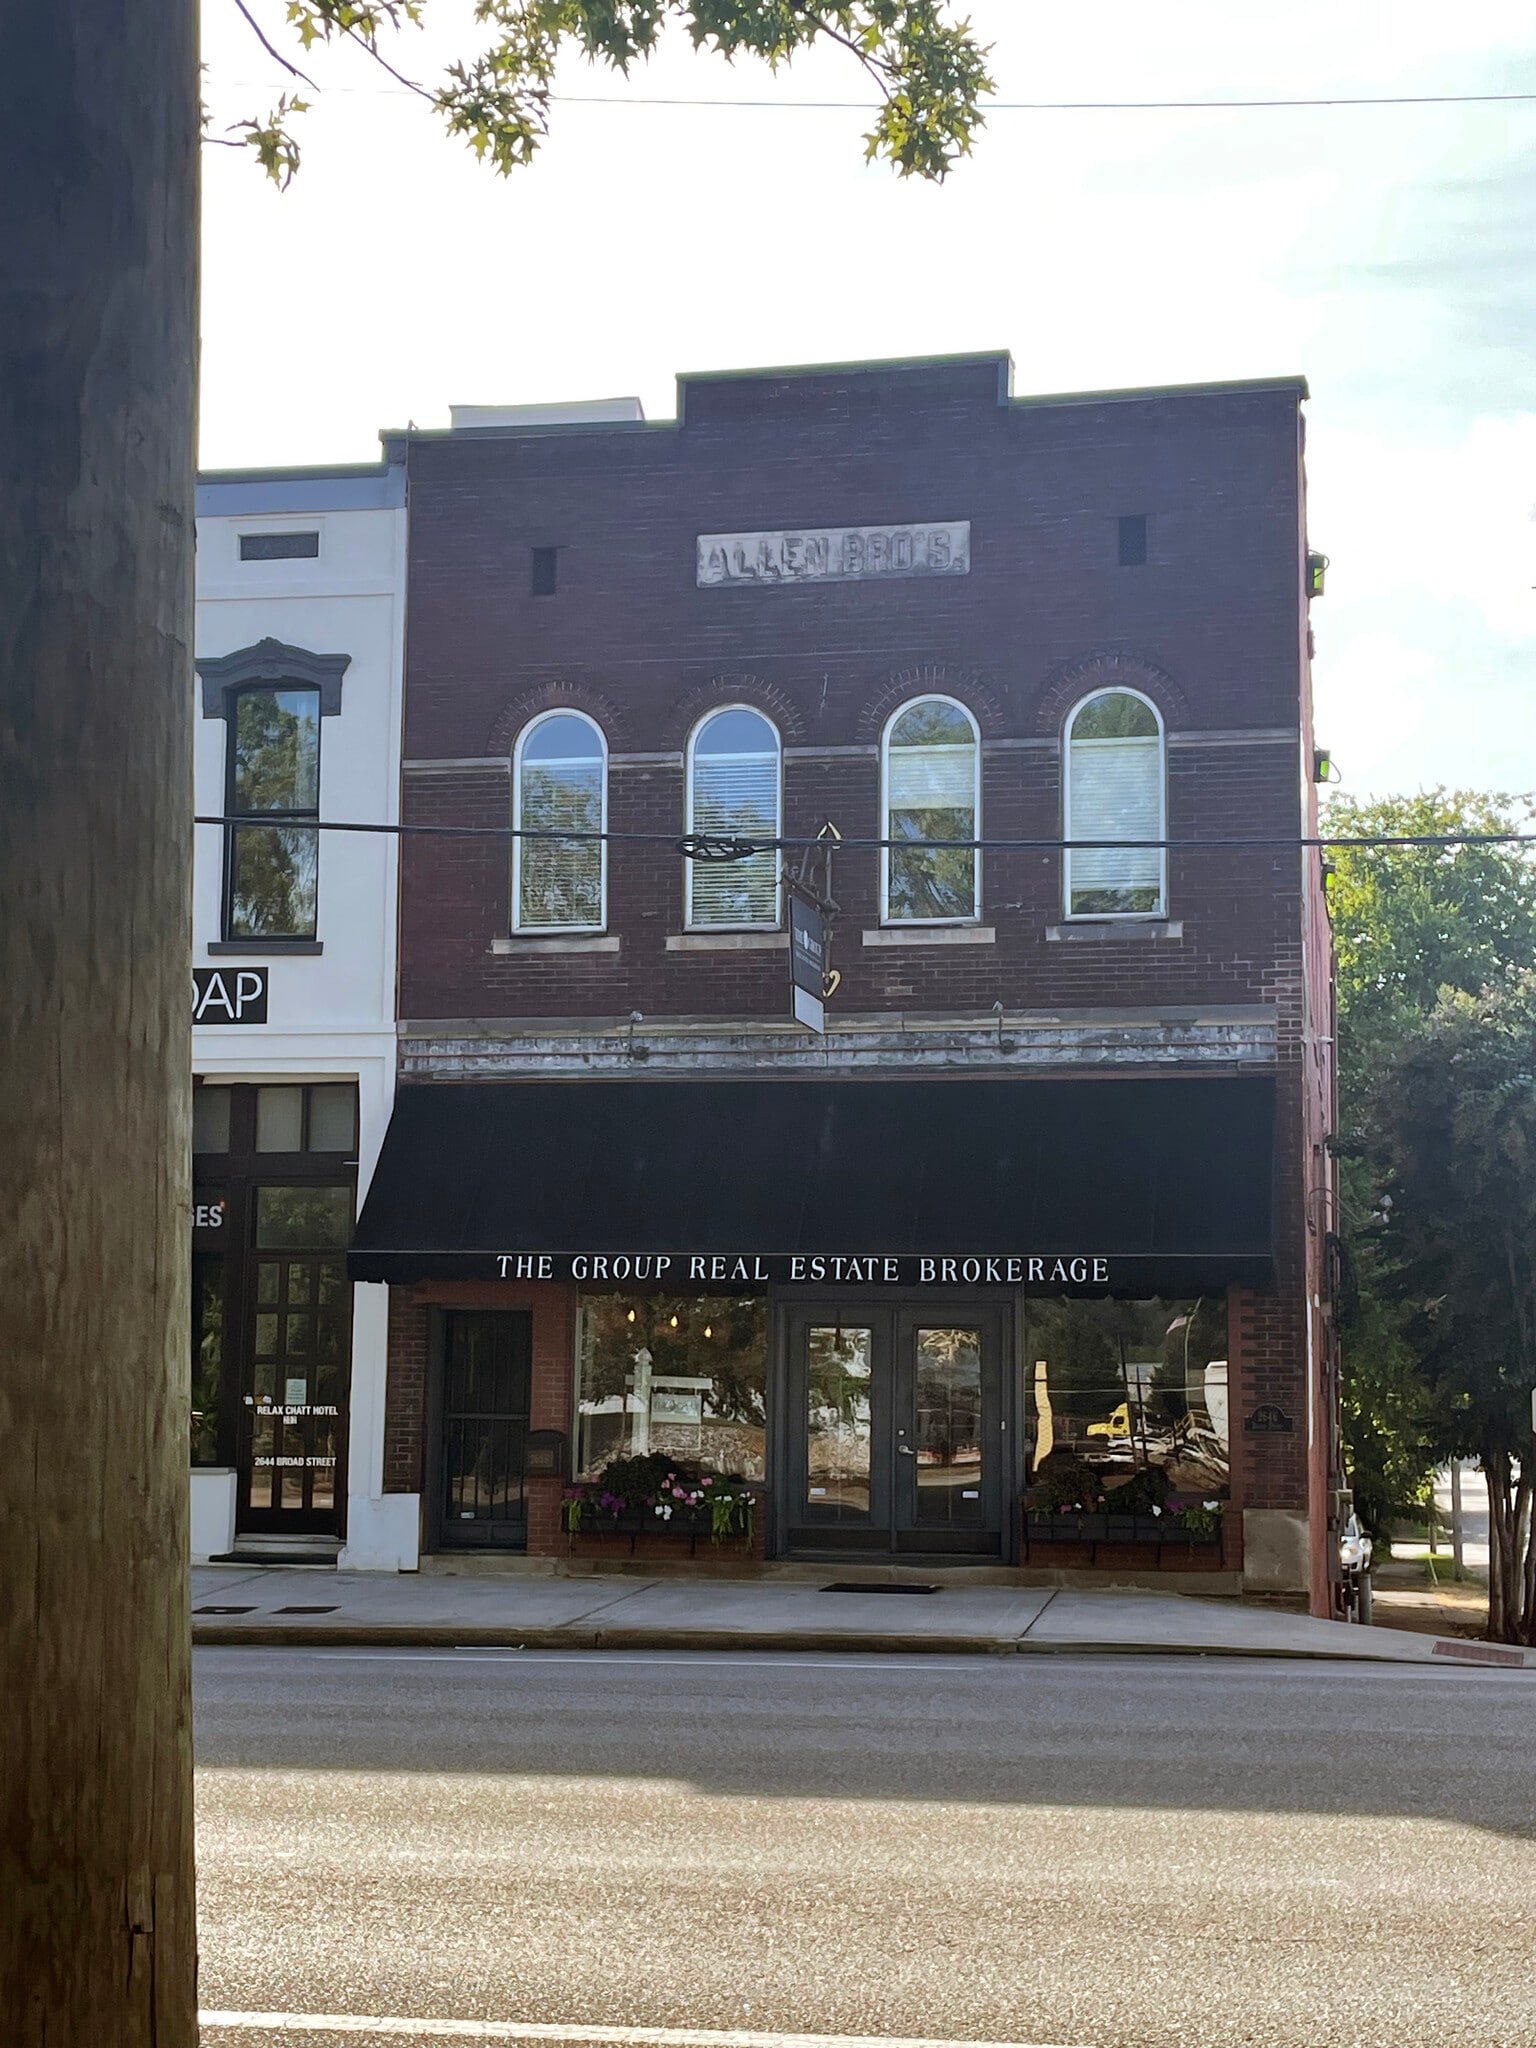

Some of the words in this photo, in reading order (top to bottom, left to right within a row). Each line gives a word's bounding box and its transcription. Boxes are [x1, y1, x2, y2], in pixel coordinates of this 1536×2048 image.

[701, 536, 829, 582] ALLEN
[192, 972, 263, 1019] AP
[192, 1205, 223, 1228] ES
[497, 1255, 553, 1278] THE
[571, 1255, 671, 1280] GROUP
[688, 1256, 770, 1280] REAL
[790, 1256, 899, 1281] ESTATE
[919, 1257, 1110, 1283] BROKERAGE
[256, 1405, 284, 1415] RELAX
[285, 1405, 311, 1415] CHATT
[312, 1405, 339, 1415] HOTEL
[254, 1457, 275, 1466] 2644
[276, 1457, 304, 1466] BROAD
[306, 1457, 337, 1467] STREET
